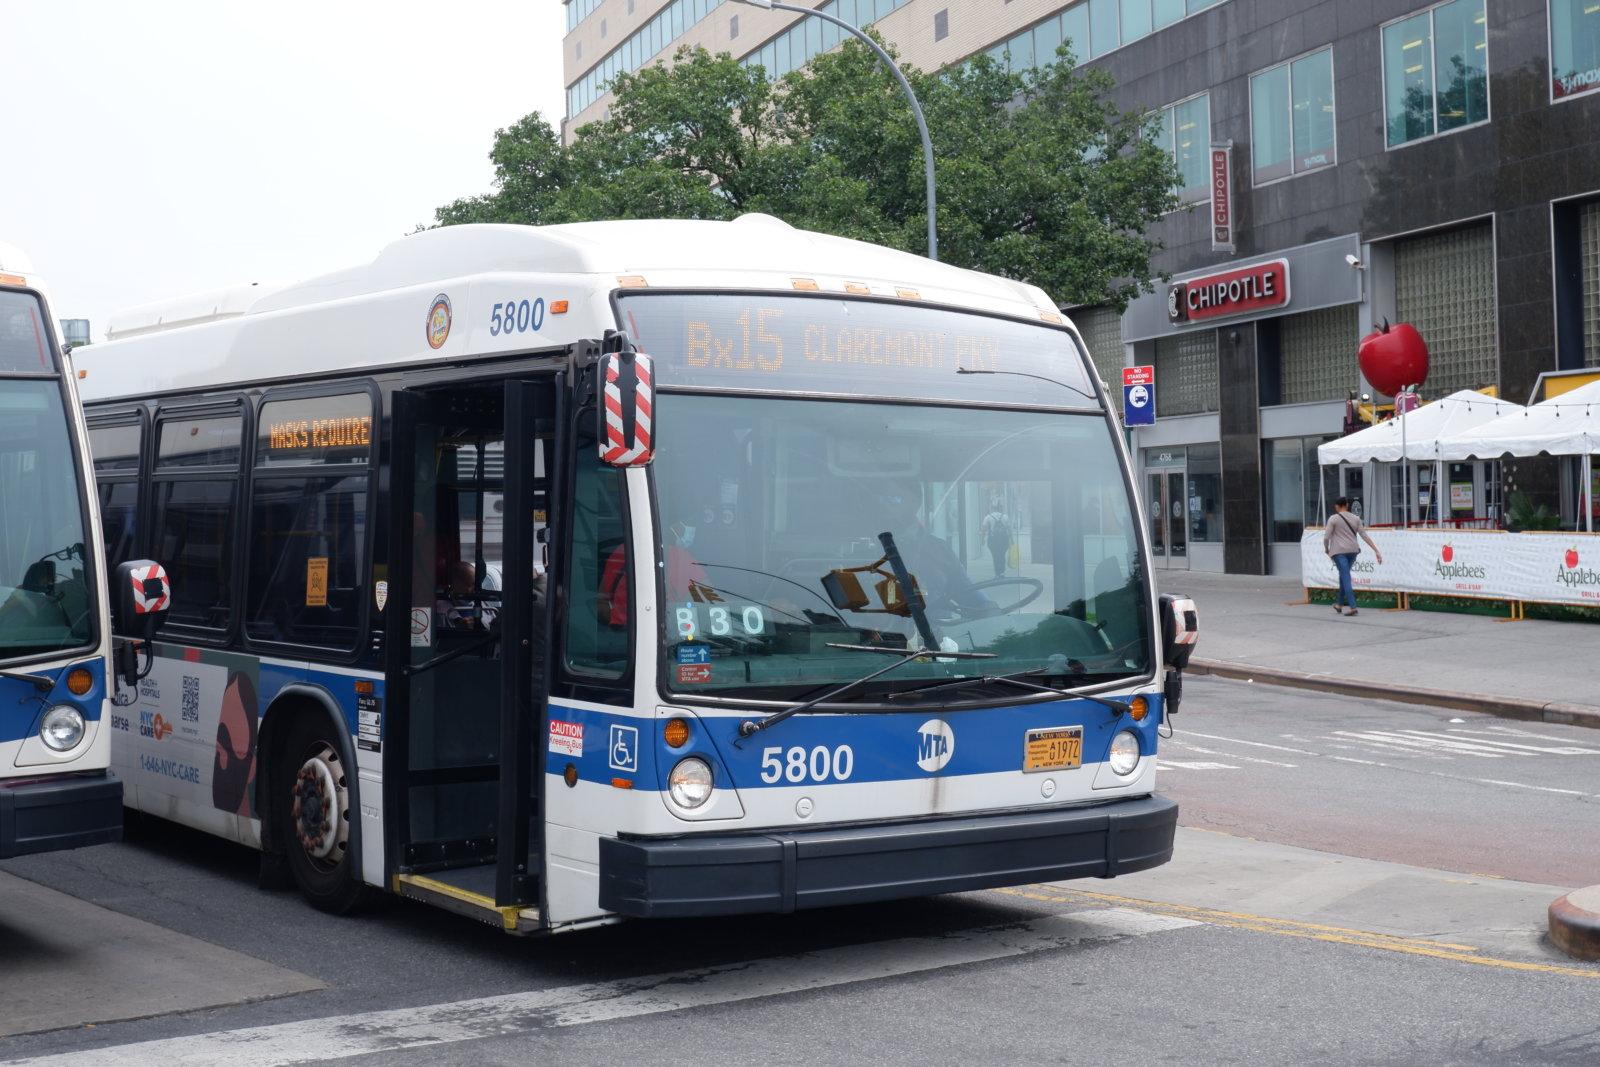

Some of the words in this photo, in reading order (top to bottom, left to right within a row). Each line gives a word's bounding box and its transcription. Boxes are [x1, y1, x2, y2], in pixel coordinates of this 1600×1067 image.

[1215, 154, 1226, 222] CHIPOTLE
[1187, 272, 1274, 310] CHIPOTLE
[490, 297, 544, 336] 5800
[688, 307, 784, 371] Bx15
[803, 324, 945, 367] CLAREMONT
[954, 335, 1001, 371] PKY
[270, 422, 308, 448] MASKS
[312, 417, 372, 447] REQUIRE
[1434, 557, 1485, 580] Applebee's
[140, 711, 154, 727] NYC
[140, 724, 154, 739] CARE
[551, 721, 582, 738] CAUTION
[549, 736, 571, 748] Kneeling
[571, 739, 582, 749] Bus
[1057, 740, 1079, 759] 1972
[140, 753, 200, 784] 1-646-NYC-CARE
[760, 744, 854, 783] 5800
